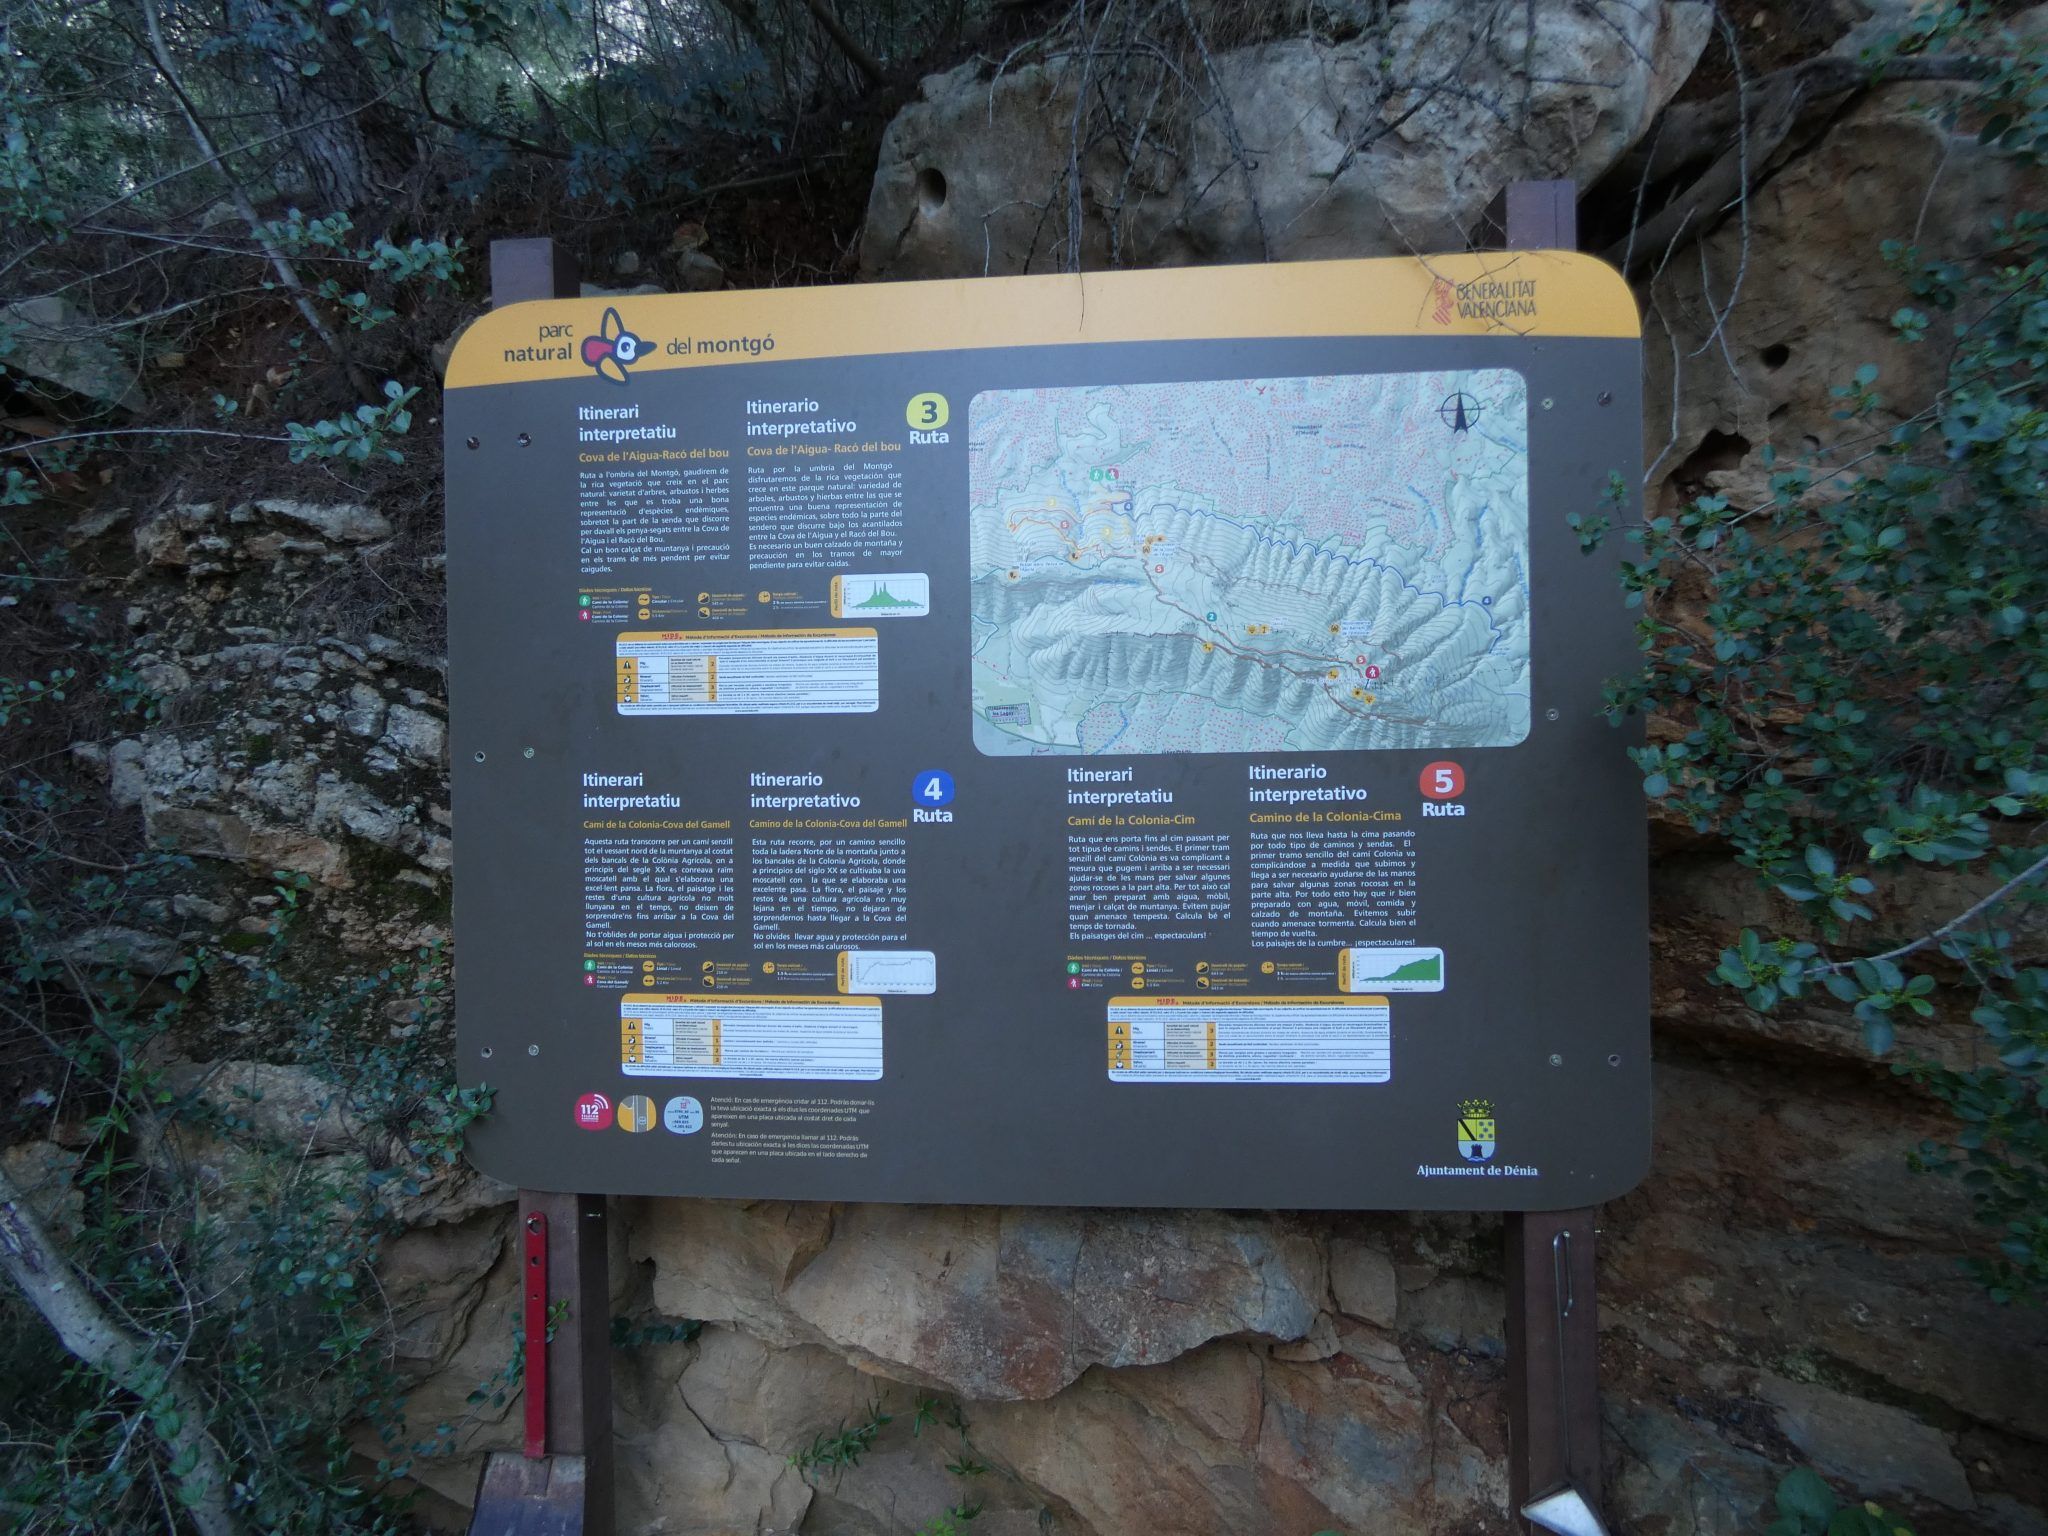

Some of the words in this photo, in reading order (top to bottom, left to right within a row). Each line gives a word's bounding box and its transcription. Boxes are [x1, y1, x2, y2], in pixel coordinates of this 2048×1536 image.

[1456, 280, 1536, 300] GENERALITAT
[1457, 300, 1536, 319] VALENCIANA
[539, 323, 573, 342] parc
[504, 343, 572, 361] natural
[667, 337, 691, 355] del
[697, 334, 775, 356] montgó
[579, 405, 639, 420] Itinerari
[747, 399, 819, 414] Itinerario
[922, 401, 937, 423] 3
[580, 426, 676, 444] interpretatiu
[747, 420, 857, 438] interpretativo
[910, 430, 949, 445] Ruta
[579, 453, 605, 462] Cova
[607, 452, 621, 462] de
[623, 449, 688, 463] l'Aigua-Racó
[689, 448, 706, 458] del
[709, 448, 729, 458] bou
[747, 446, 773, 456] Cova
[775, 445, 789, 455] de
[791, 444, 832, 456] l'Aigua-
[834, 443, 860, 453] Racó
[861, 442, 878, 452] del
[880, 441, 901, 451] bou
[844, 472, 883, 482] vegetación
[835, 500, 888, 510] representación
[750, 562, 785, 571] pendiente
[584, 773, 643, 786] Itinerari
[751, 773, 823, 786] Itinerario
[1068, 768, 1132, 782] Itinerari
[1249, 765, 1327, 780] Itinerario
[1436, 770, 1453, 792] 5
[924, 778, 942, 800] 4
[1250, 786, 1367, 805] interpretativo
[584, 794, 680, 811] interpretatiu
[751, 794, 860, 811] interpretativo
[1068, 789, 1172, 807] interpretatiu
[914, 808, 953, 823] Ruta
[1250, 812, 1293, 823] Camino
[1295, 812, 1310, 822] de
[1312, 812, 1323, 822] la
[1326, 811, 1402, 822] Colonia-Cima
[1423, 802, 1465, 817] Ruta
[606, 820, 618, 829] de
[618, 820, 627, 829] la
[628, 820, 684, 829] Colonia-Cova
[685, 820, 700, 829] del
[700, 820, 730, 829] Gamell
[750, 820, 781, 828] Camino
[782, 819, 794, 828] de
[796, 819, 803, 828] la
[805, 819, 861, 828] Colonia-Cova
[862, 819, 877, 828] del
[878, 819, 907, 828] Gamell
[1098, 815, 1112, 826] de
[1115, 816, 1125, 825] la
[1128, 814, 1195, 825] Colonia-Cim
[585, 866, 614, 874] principis
[633, 866, 651, 874] segle
[655, 875, 670, 884] qual
[1114, 894, 1146, 902] preparat
[1177, 893, 1200, 902] aigua,
[1251, 900, 1291, 910] preparado
[753, 914, 804, 922] sorprendernos
[830, 914, 851, 923] llegar
[1133, 913, 1170, 921] tempesta.
[1252, 930, 1279, 939] tiempo
[581, 1105, 598, 1114] 112
[1417, 1165, 1485, 1177] Ajuntament
[1487, 1165, 1502, 1176] de
[1504, 1165, 1538, 1176] Dénia
